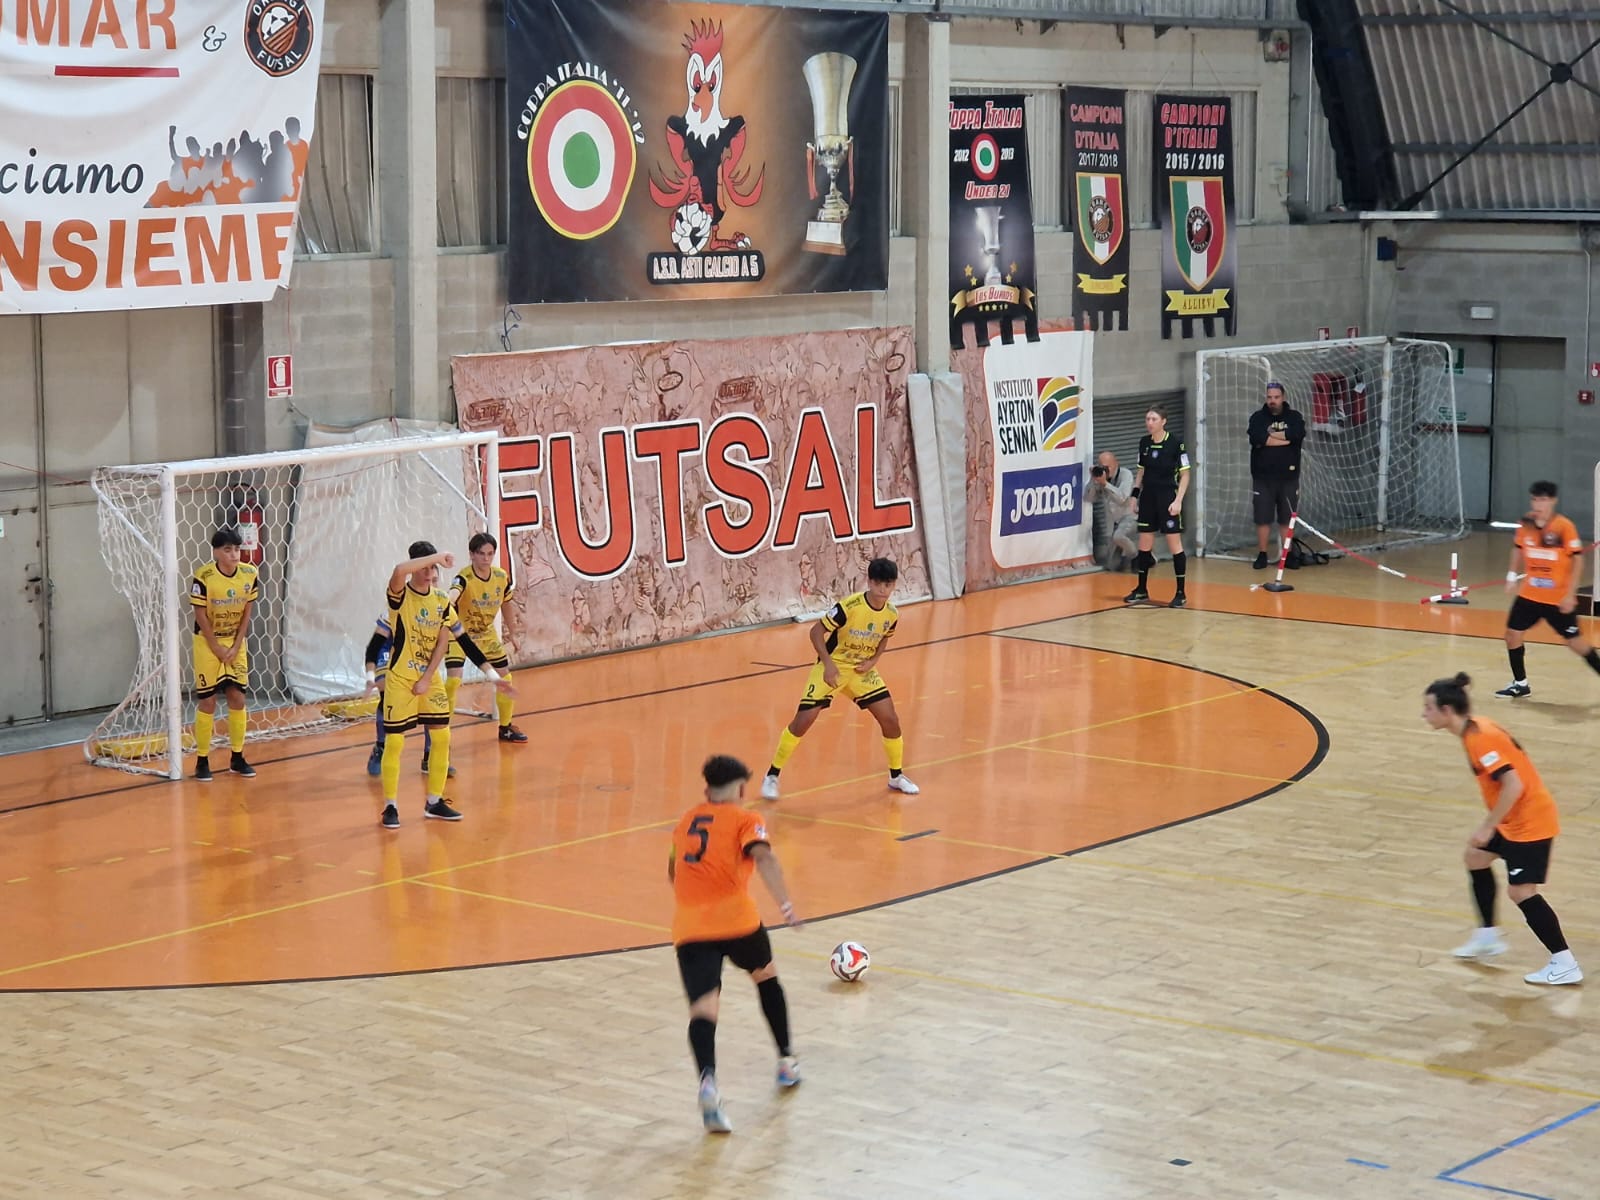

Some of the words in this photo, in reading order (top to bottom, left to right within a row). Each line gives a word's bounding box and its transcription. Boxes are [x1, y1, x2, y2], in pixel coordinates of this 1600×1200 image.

[0, 0, 177, 49] MAR
[202, 25, 227, 52] &
[517, 74, 557, 140] COPPA
[557, 61, 608, 87] ITALIA
[1070, 103, 1123, 125] CAMPIONI
[1160, 102, 1226, 126] CAMPIONI
[1075, 130, 1119, 150] D'ITALIA
[1164, 127, 1218, 149] D'ITALIA
[1099, 153, 1119, 167] 2018
[1165, 153, 1189, 170] 2015
[1198, 153, 1225, 170] 2016
[681, 256, 702, 279] ASTI
[704, 255, 740, 278] CALCIO
[993, 378, 1033, 399] INSTITUTO
[997, 399, 1036, 426] AYRTON
[999, 424, 1038, 456] SENNA
[477, 402, 916, 589] FUTSAL
[199, 674, 207, 687] 3
[807, 684, 815, 697] 2
[387, 705, 393, 719] 7
[683, 814, 714, 864] 5
